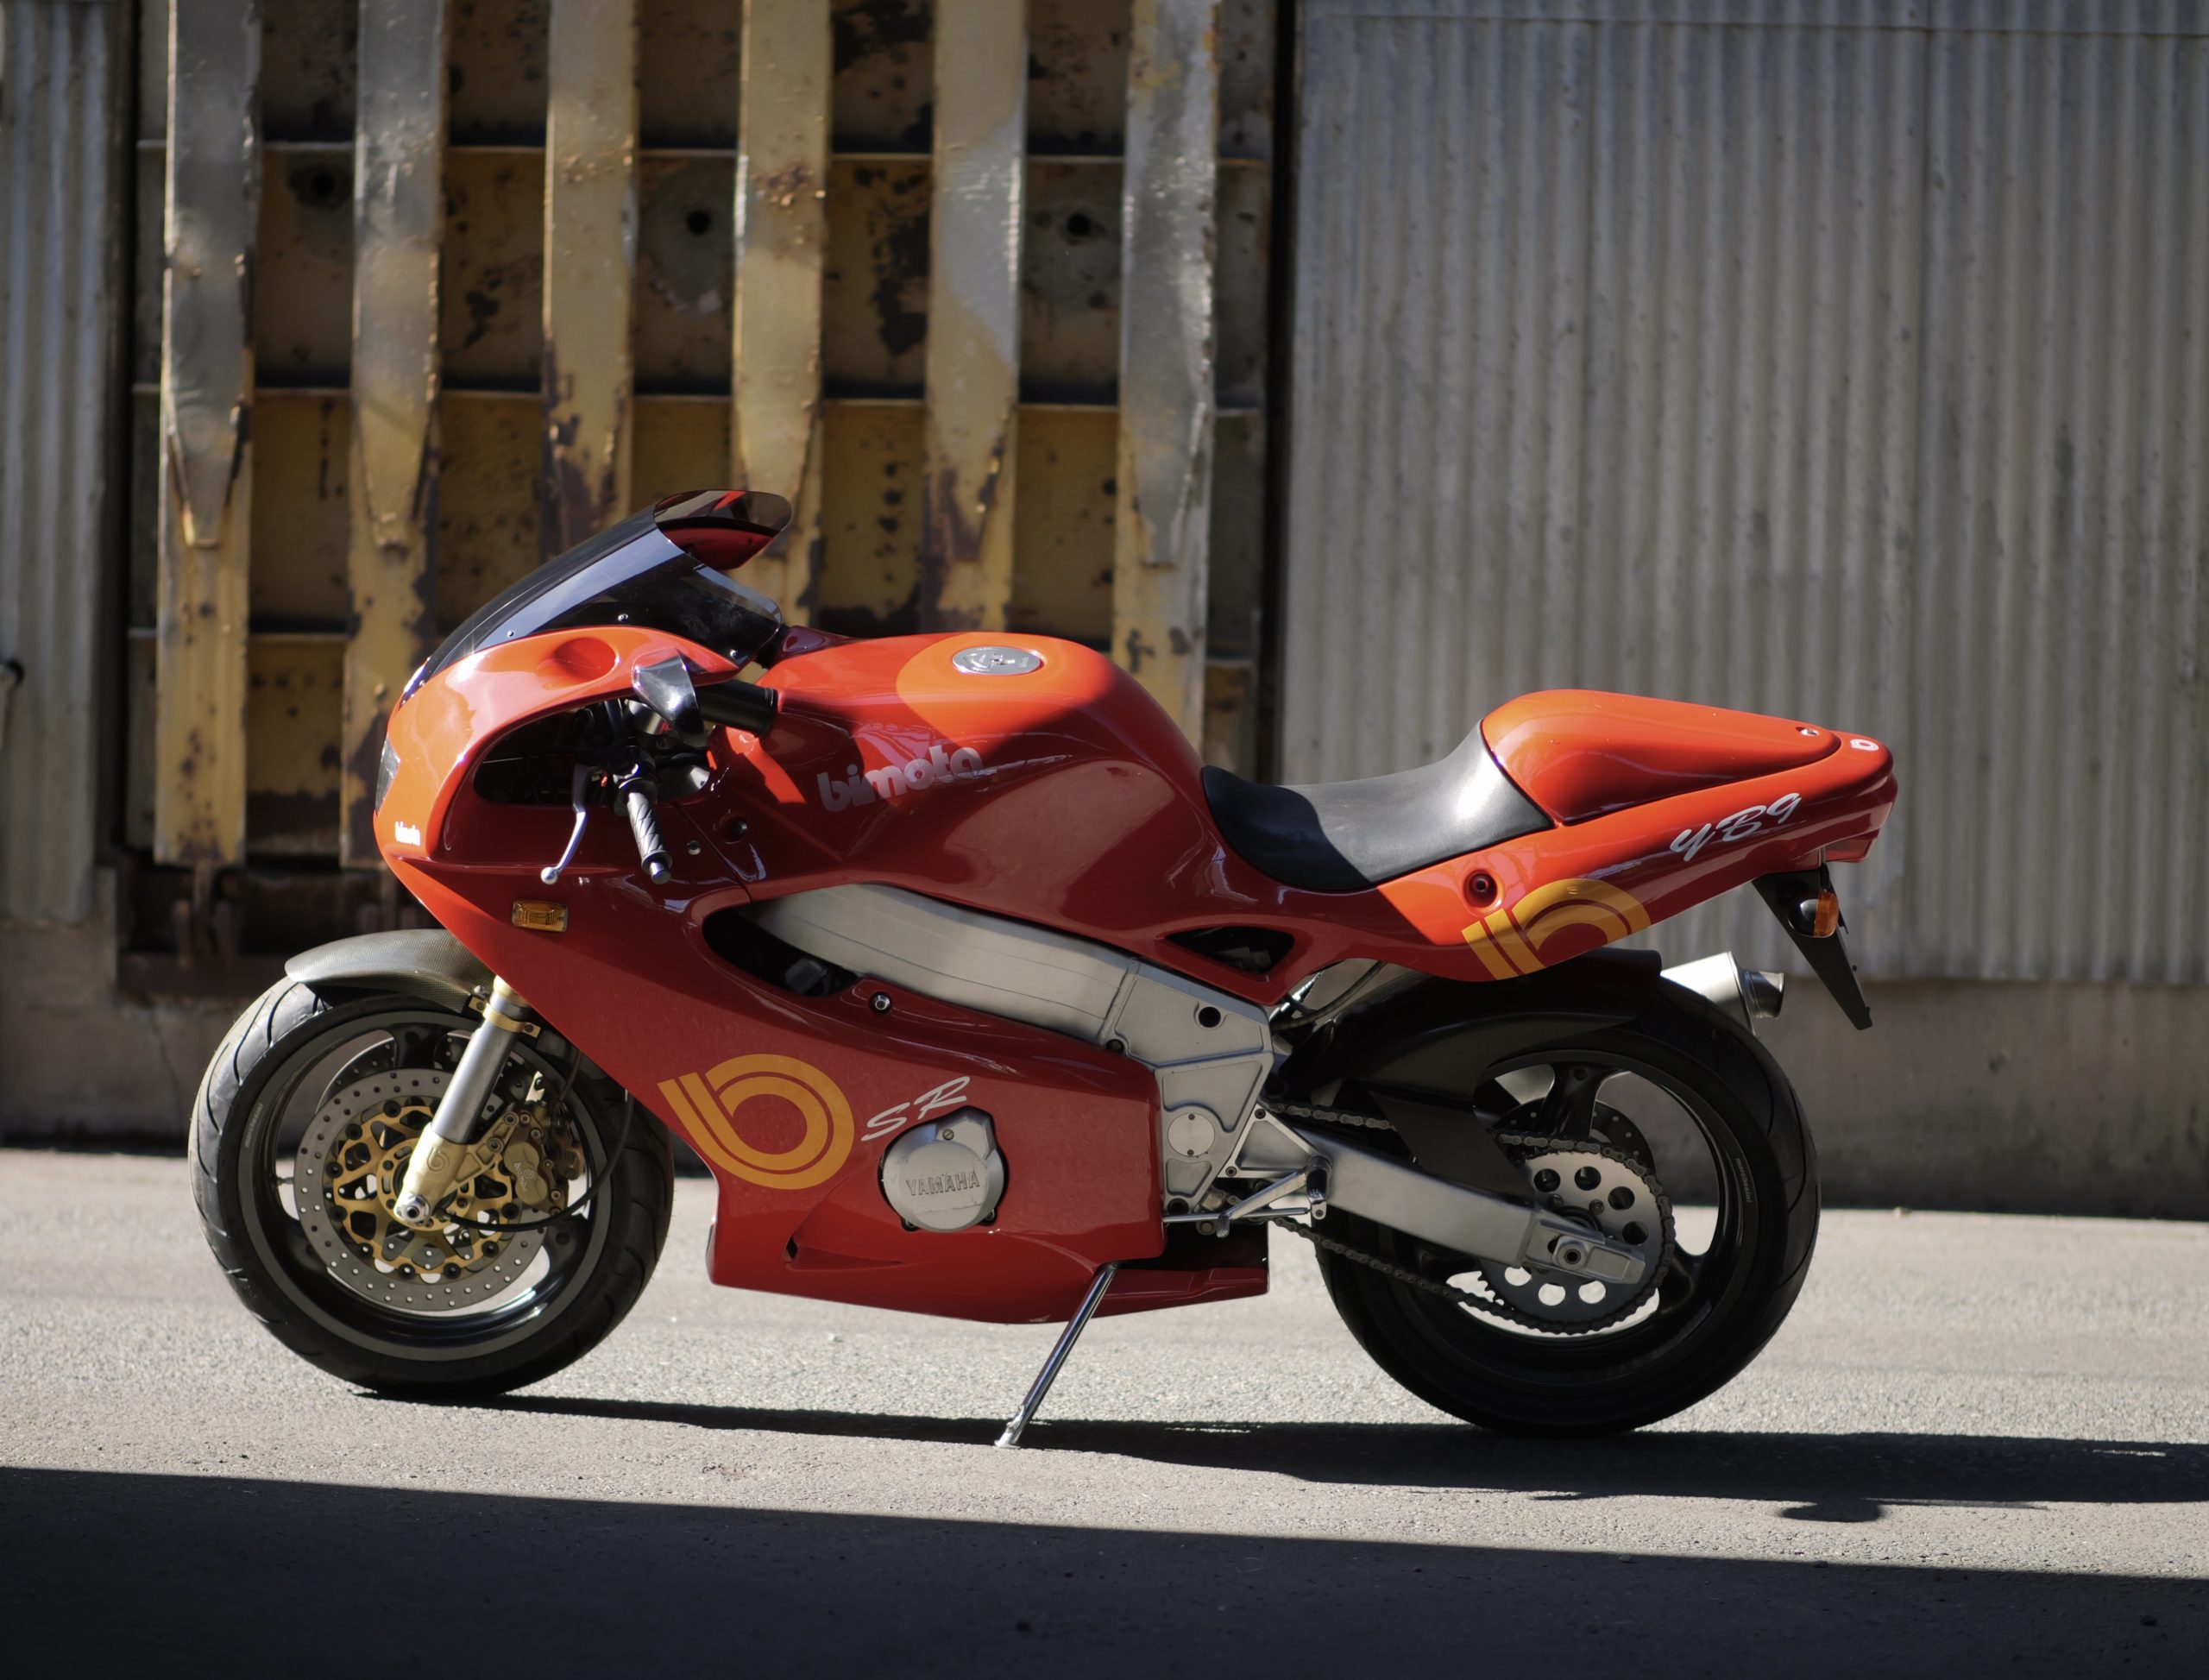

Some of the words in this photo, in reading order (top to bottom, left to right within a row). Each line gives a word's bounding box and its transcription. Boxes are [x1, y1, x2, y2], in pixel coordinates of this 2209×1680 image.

[817, 745, 983, 812] bimota
[861, 1076, 970, 1141] SR
[906, 1168, 980, 1196] YAMAHA
